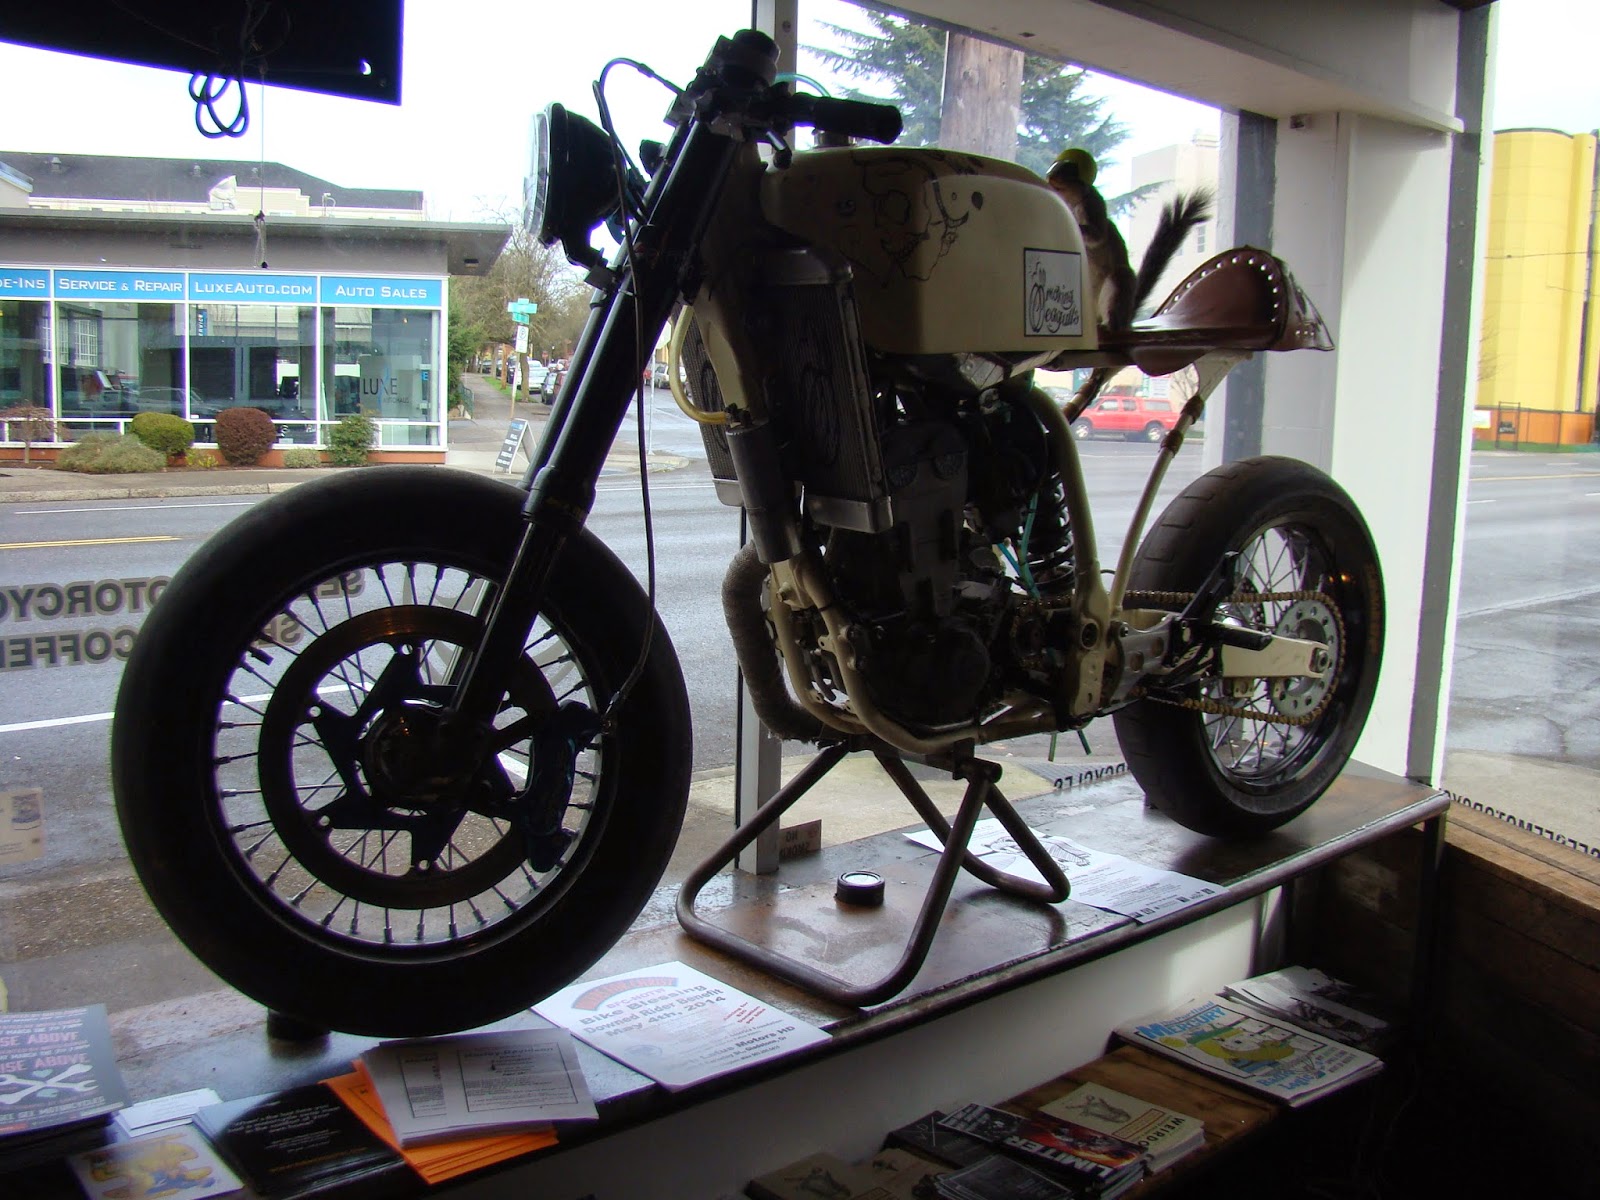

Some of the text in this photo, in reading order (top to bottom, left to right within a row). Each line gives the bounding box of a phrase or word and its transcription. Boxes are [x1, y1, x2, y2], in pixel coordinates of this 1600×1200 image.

[121, 282, 129, 291] &
[363, 378, 398, 395] LUXE
[579, 1008, 624, 1025] Bike
[626, 984, 708, 1011] Blessing
[583, 1012, 640, 1034] Downed
[641, 1001, 675, 1017] Rider
[676, 988, 724, 1006] Benefit
[604, 1021, 643, 1037] May
[648, 1010, 683, 1024] 4th,
[684, 996, 727, 1012] 2014
[735, 1031, 777, 1048] Motors
[1136, 1006, 1229, 1040] MERCURY
[0, 1060, 27, 1074] ISE
[1004, 1135, 1117, 1179] LIMITER
